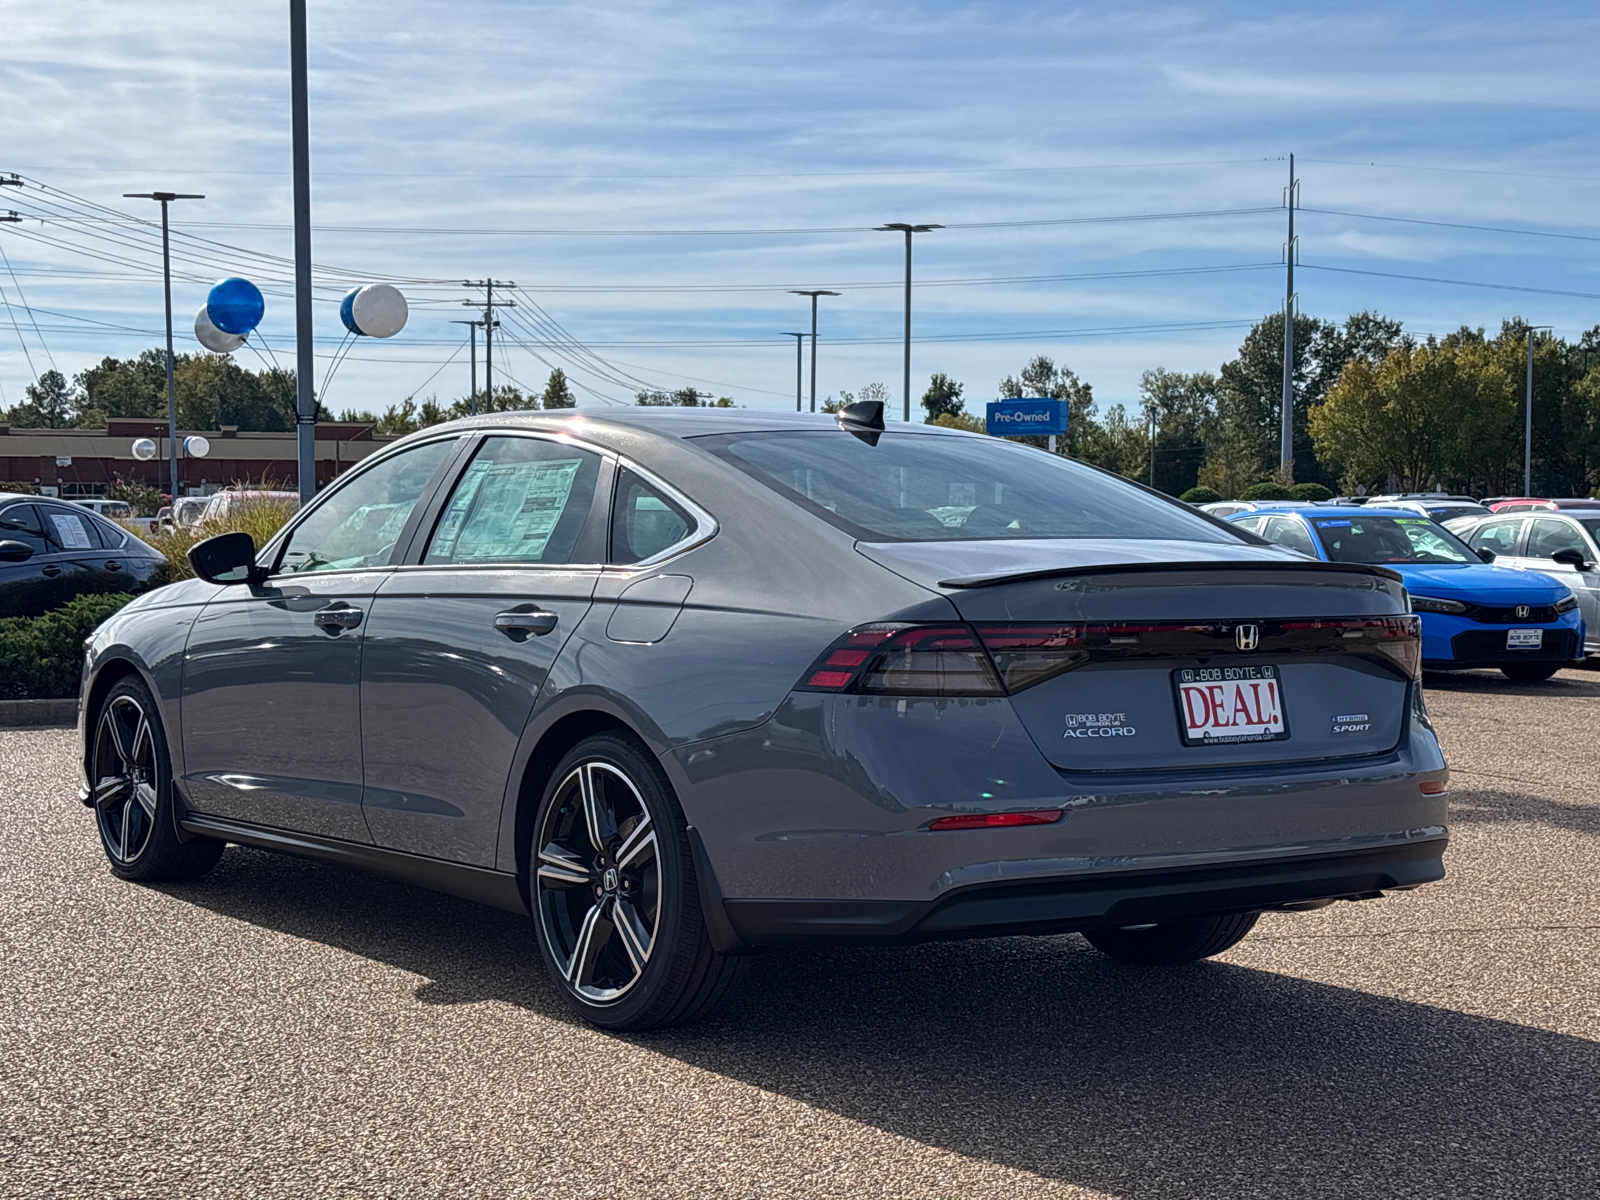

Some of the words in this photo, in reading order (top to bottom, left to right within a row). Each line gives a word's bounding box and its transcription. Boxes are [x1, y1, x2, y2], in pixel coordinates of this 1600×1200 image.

[994, 411, 1050, 423] Pre-Owned
[1200, 668, 1221, 681] BOB
[1224, 667, 1257, 680] BOYTE
[1181, 681, 1279, 729] DEAL!
[1078, 714, 1096, 722] BOB
[1098, 713, 1126, 722] BOYTE
[1063, 726, 1136, 739] ACCORD
[1332, 724, 1371, 733] SPORT
